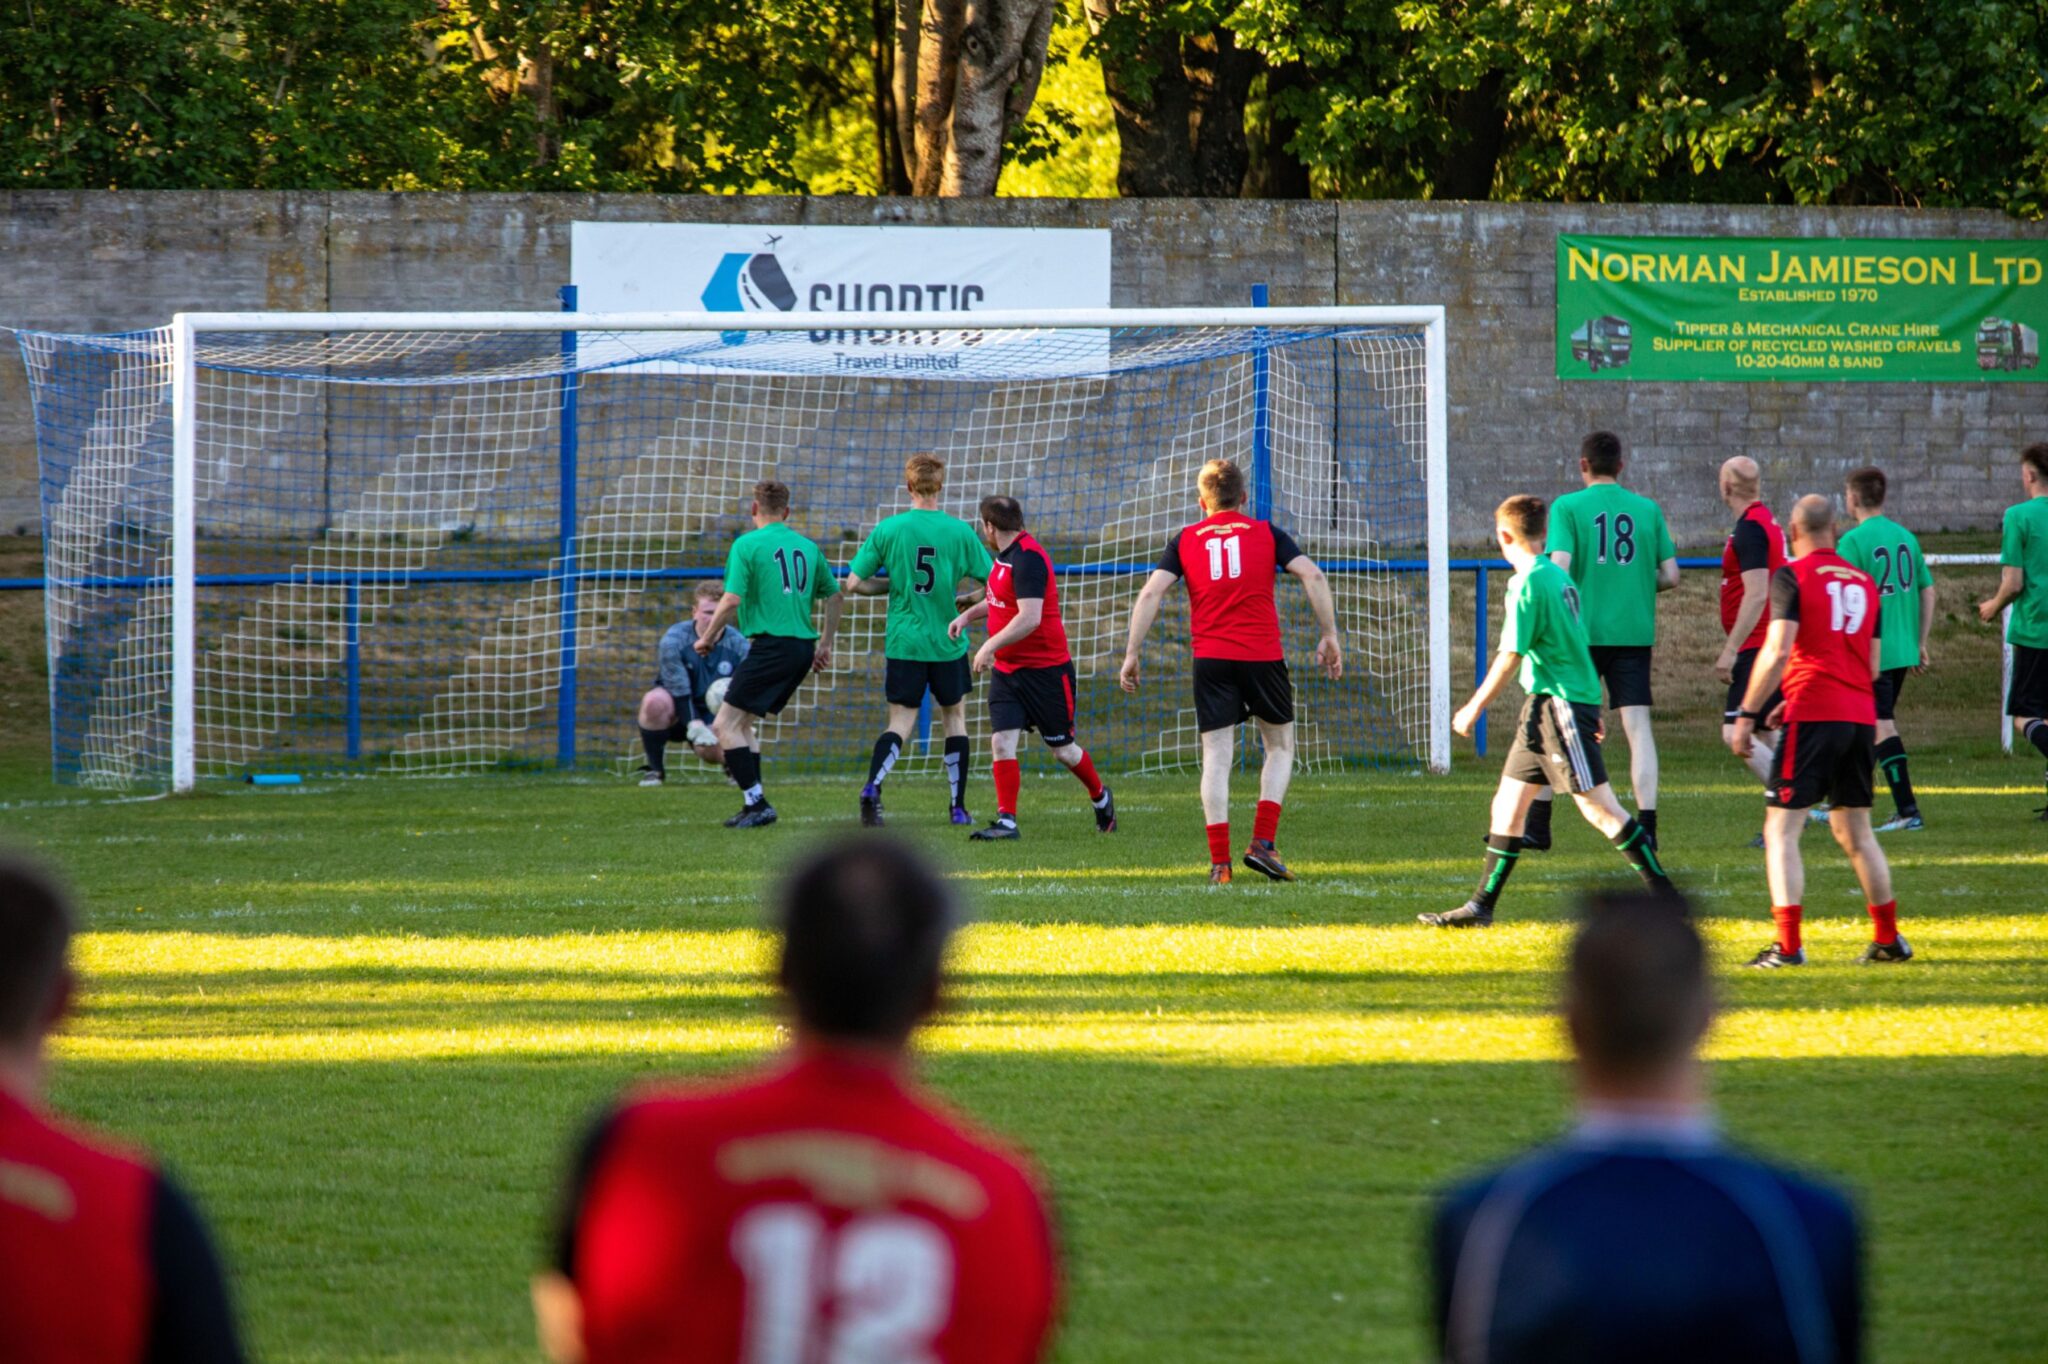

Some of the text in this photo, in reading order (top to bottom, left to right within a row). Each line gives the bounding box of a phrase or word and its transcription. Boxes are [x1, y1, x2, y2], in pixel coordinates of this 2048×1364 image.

[1567, 247, 2043, 286] NORMAN JAMIESON LTD
[1738, 287, 1878, 302] ESTABLISHED 1970
[1652, 336, 1962, 353] SUPPLIER OF RECYCLED WASHED GRAVELS
[1674, 321, 1940, 337] TIPPER & MECHANICAL CRANE HIRE
[833, 352, 959, 370] Travel Limited
[1735, 354, 1884, 369] 10-20-40MM & SAND
[1205, 535, 1241, 581] 11
[1594, 511, 1636, 566] 18
[774, 547, 808, 594] 10
[914, 545, 937, 595] 5
[1872, 543, 1914, 597] 20
[1825, 581, 1867, 634] 19
[728, 1202, 957, 1364] 12
